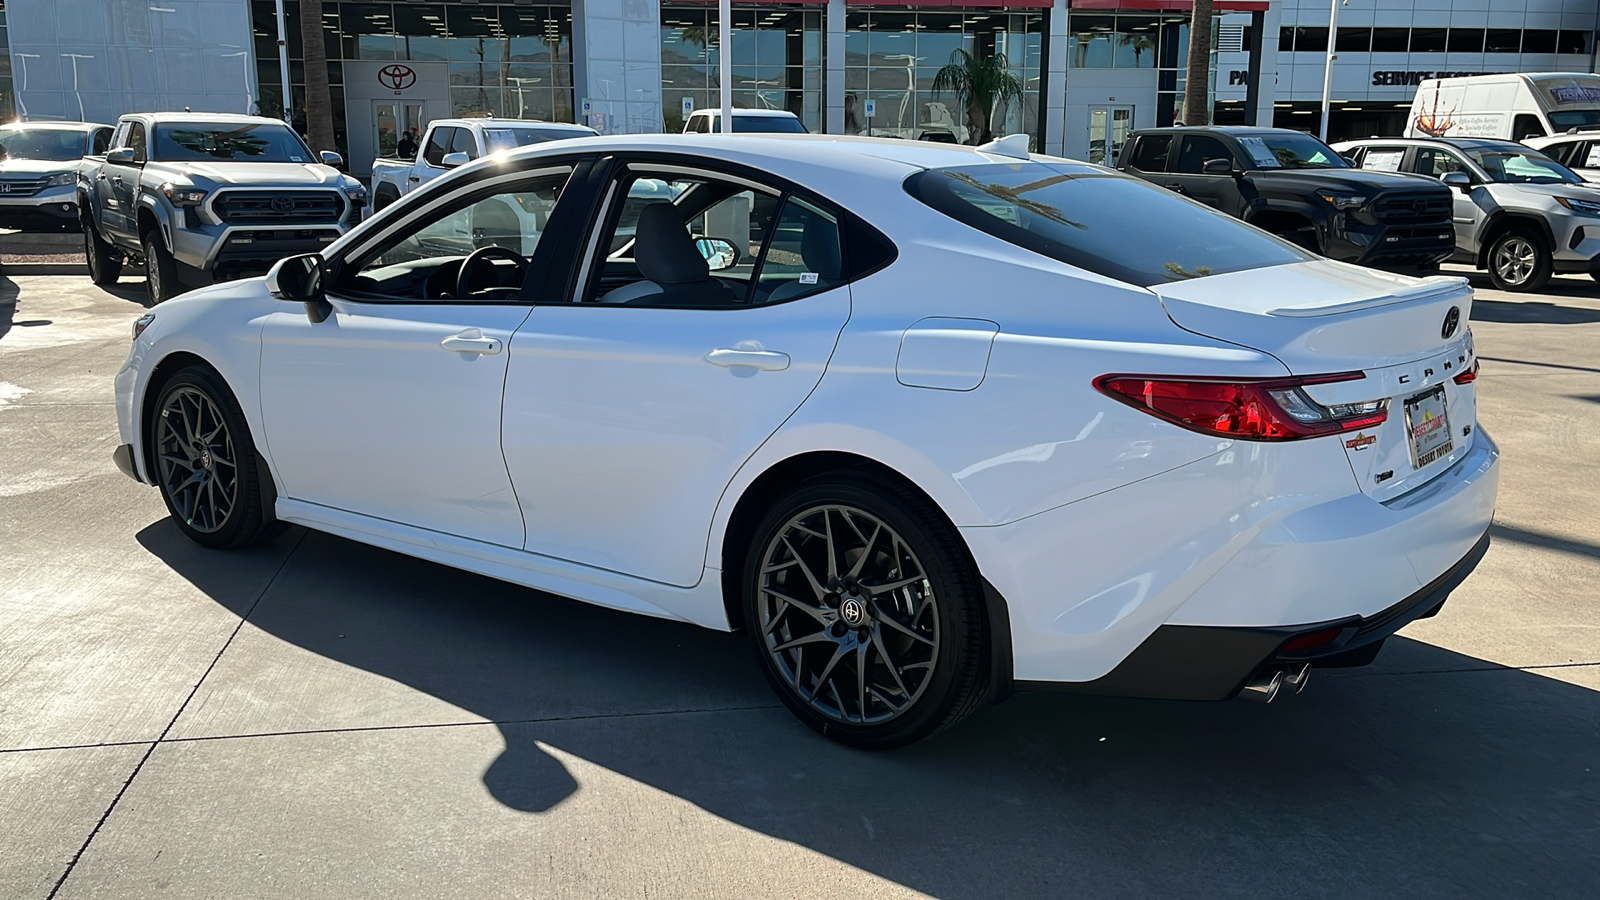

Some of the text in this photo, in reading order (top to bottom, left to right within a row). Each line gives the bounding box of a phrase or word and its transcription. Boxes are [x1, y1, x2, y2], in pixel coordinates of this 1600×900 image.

[1372, 71, 1434, 85] SERVICE
[1471, 117, 1483, 125] Coffee
[1398, 348, 1473, 384] CAMRY
[1418, 441, 1453, 468] DESERT TOYOTA
